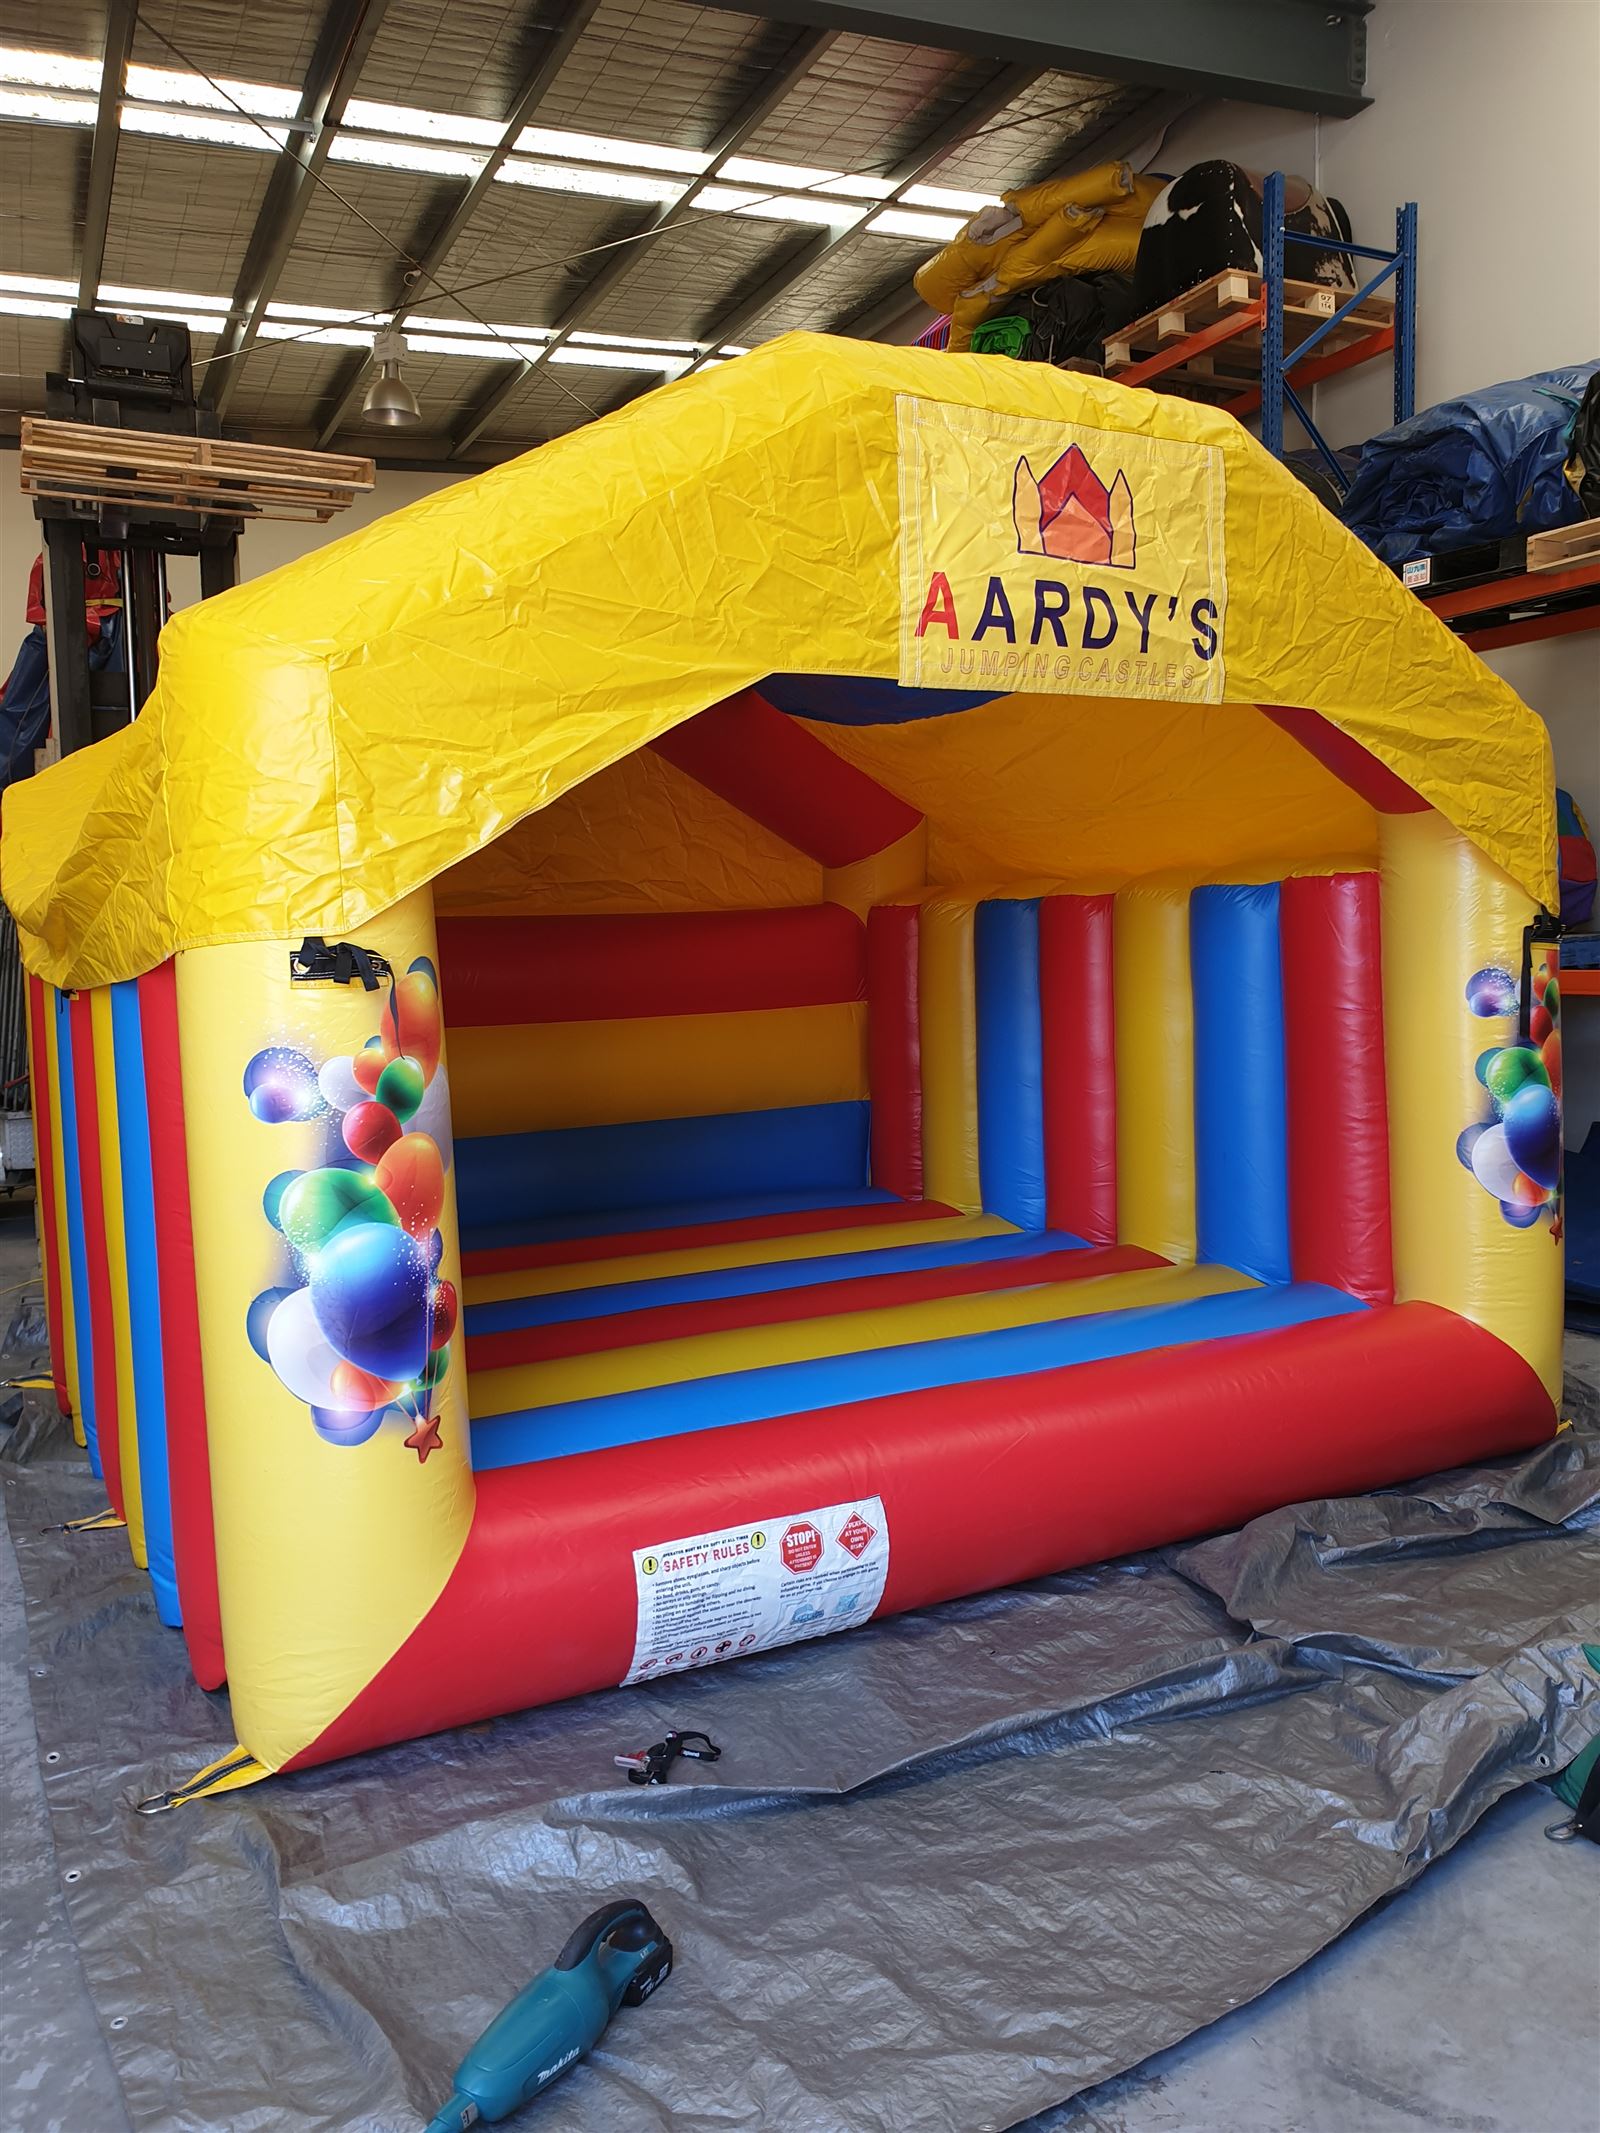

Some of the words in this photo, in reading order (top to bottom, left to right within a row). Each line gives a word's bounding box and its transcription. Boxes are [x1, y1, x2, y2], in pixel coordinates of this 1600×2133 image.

[914, 572, 1218, 661] AARDY'S
[940, 648, 1071, 679] JUMPING
[1079, 656, 1195, 688] CASTLES
[786, 1530, 815, 1547] STOP!
[664, 1552, 707, 1572] SAFETY
[714, 1542, 749, 1560] RULES
